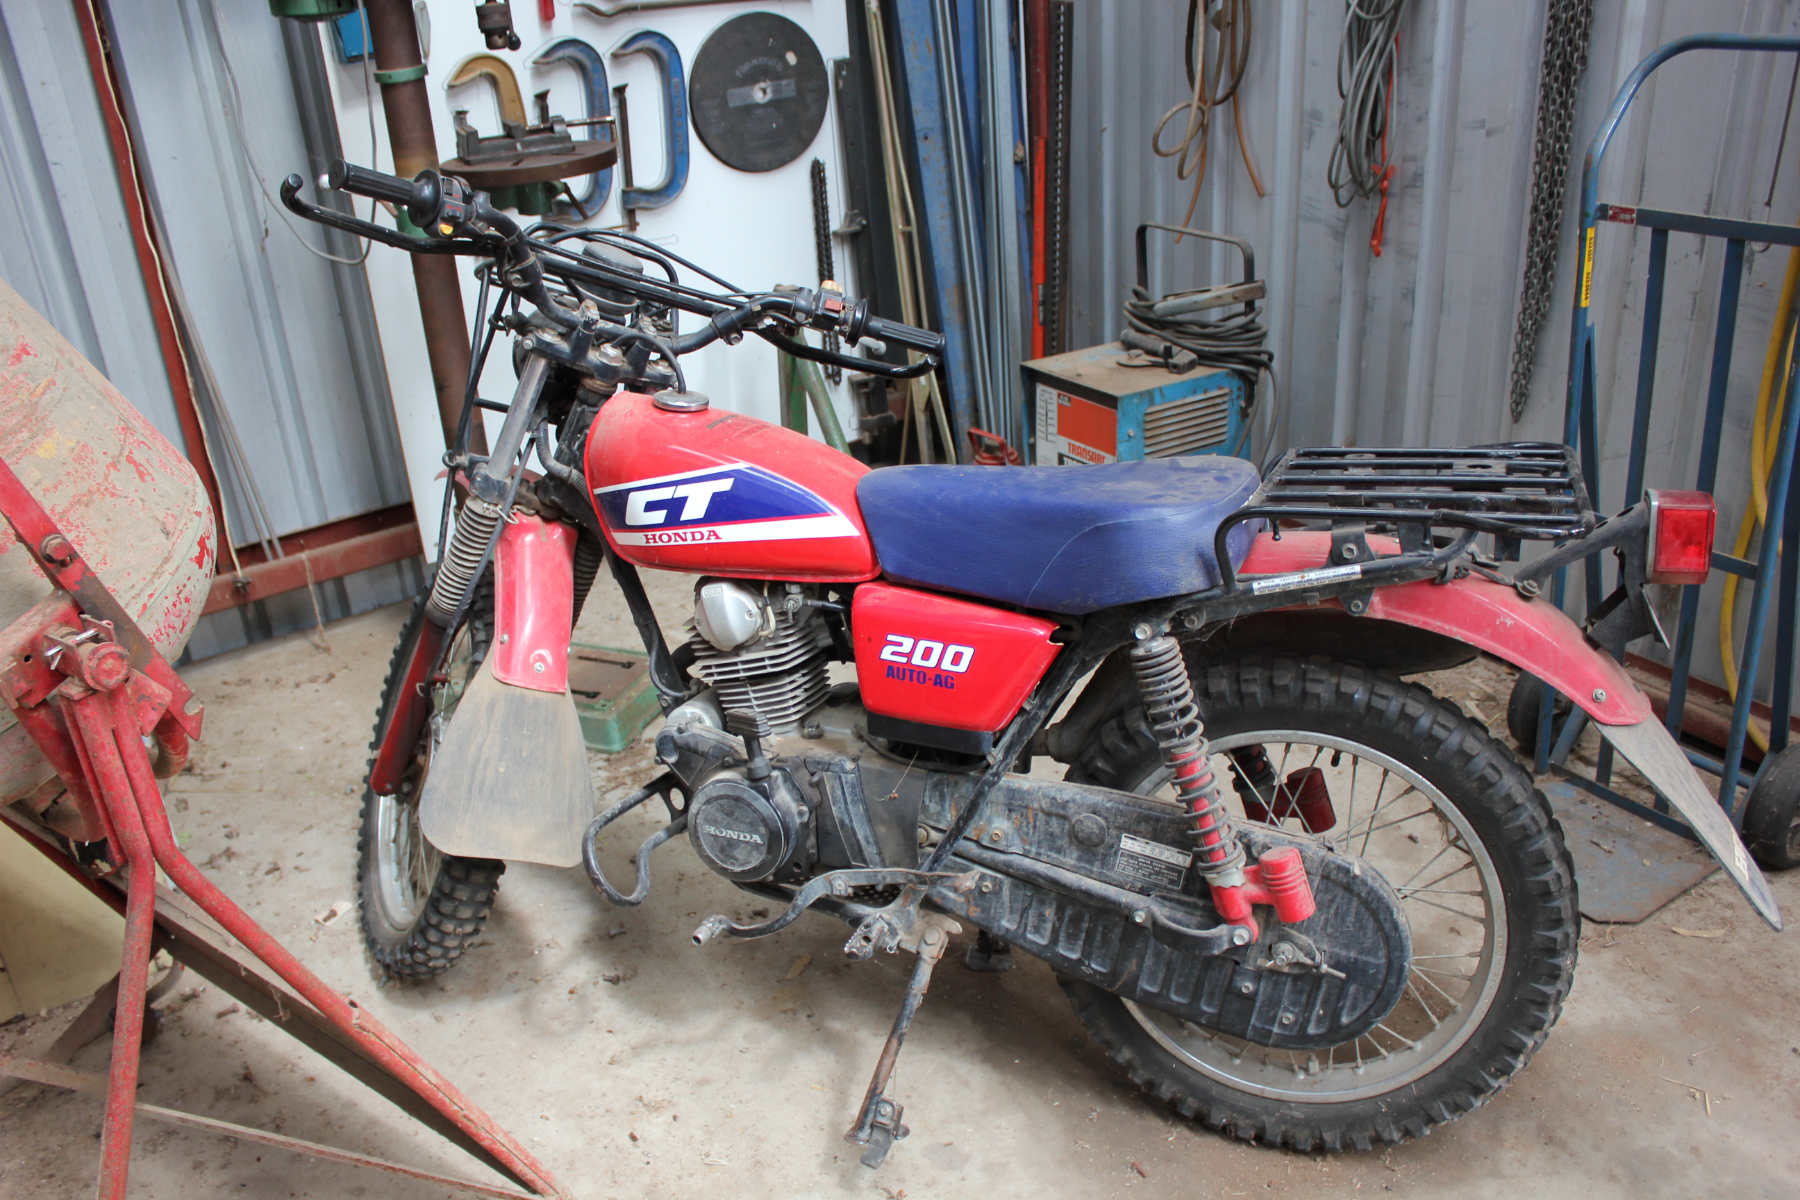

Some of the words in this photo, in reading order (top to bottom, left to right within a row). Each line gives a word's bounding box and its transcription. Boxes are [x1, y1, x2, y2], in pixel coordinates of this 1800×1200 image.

[624, 477, 735, 526] CT
[643, 529, 722, 545] HONDA
[879, 633, 976, 674] 200
[885, 665, 955, 690] AUTO-AG
[703, 824, 764, 844] HONDA
